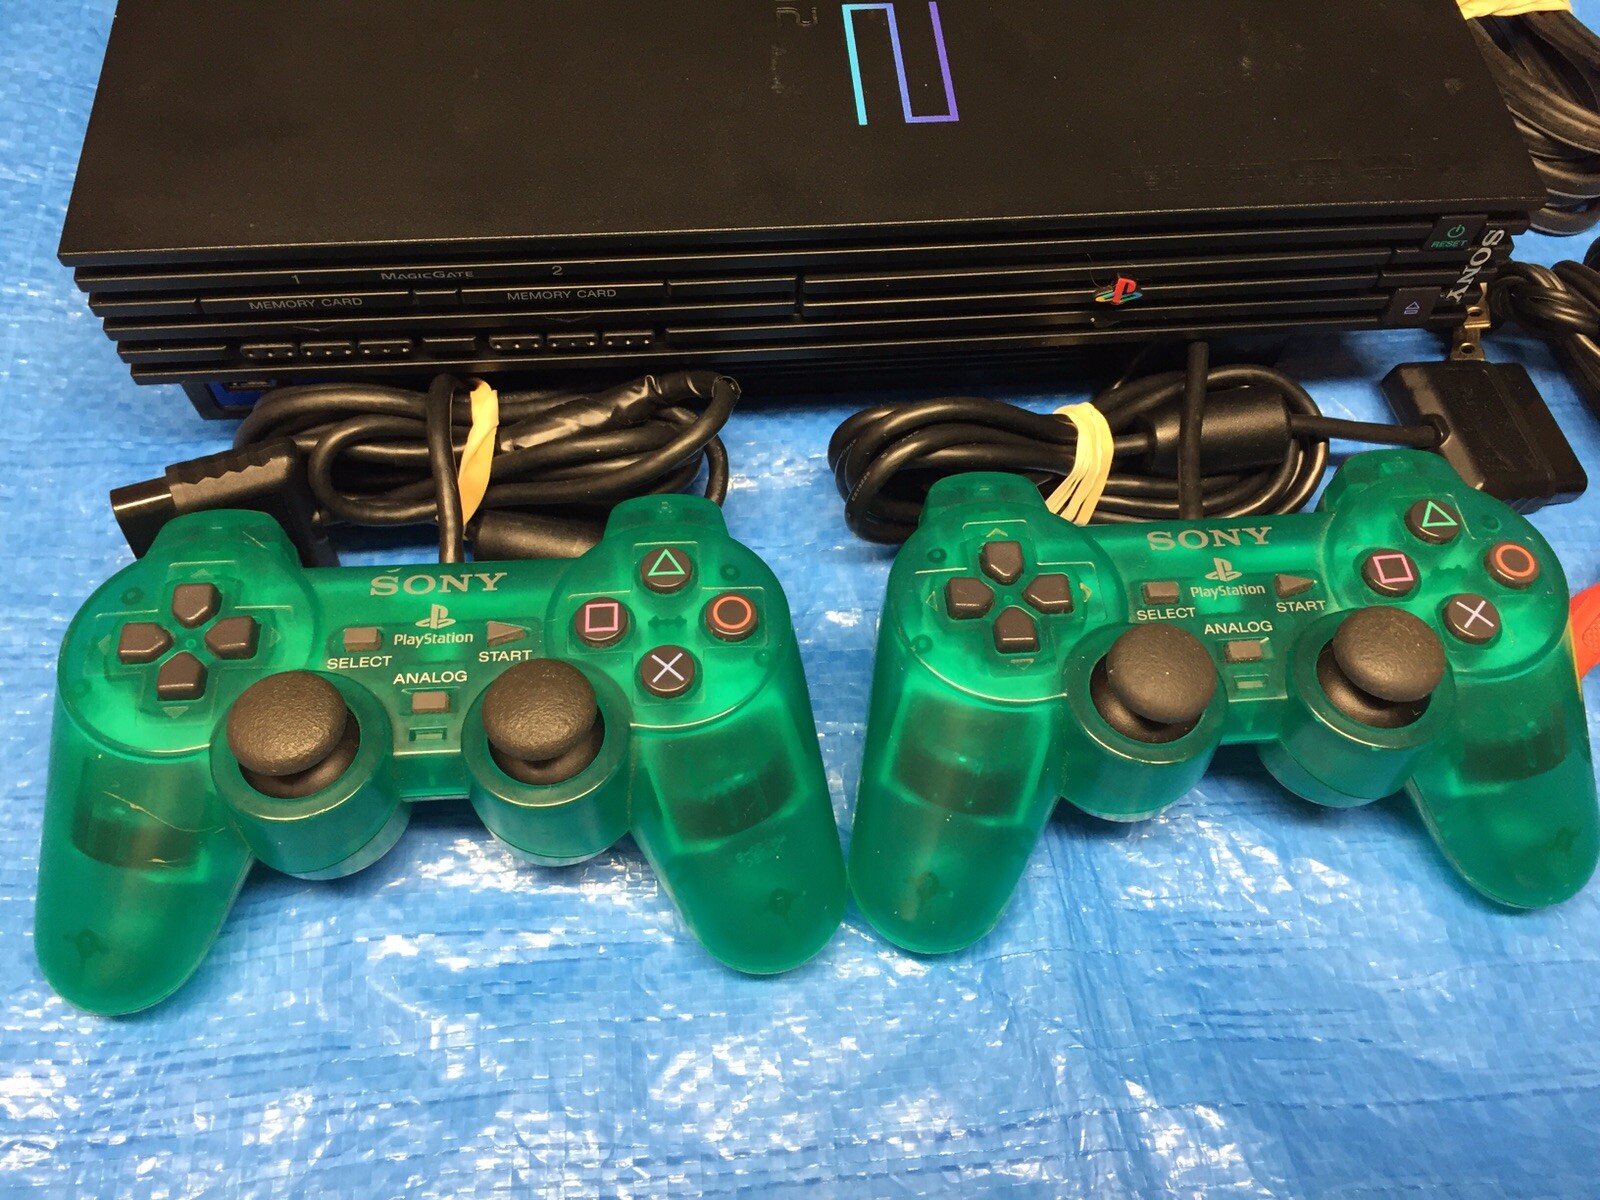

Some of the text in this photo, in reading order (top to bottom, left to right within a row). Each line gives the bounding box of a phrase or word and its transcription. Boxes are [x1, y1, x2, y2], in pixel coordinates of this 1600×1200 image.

[1431, 240, 1468, 248] RESET
[552, 265, 563, 276] 2
[1447, 229, 1505, 304] SONY
[291, 274, 301, 284] 1
[507, 289, 617, 301] MEMORY CARD
[249, 297, 363, 310] MEMORY CARD
[1147, 526, 1272, 551] SONY
[370, 572, 508, 596] SONY
[1190, 584, 1266, 600] PlayStation
[1276, 600, 1326, 613] START
[1137, 607, 1196, 621] SELECT
[1204, 620, 1274, 635] ANALOG
[393, 632, 474, 648] PlayStation
[327, 656, 392, 670] SELECT
[478, 650, 533, 662] START
[393, 670, 468, 685] ANALOG
